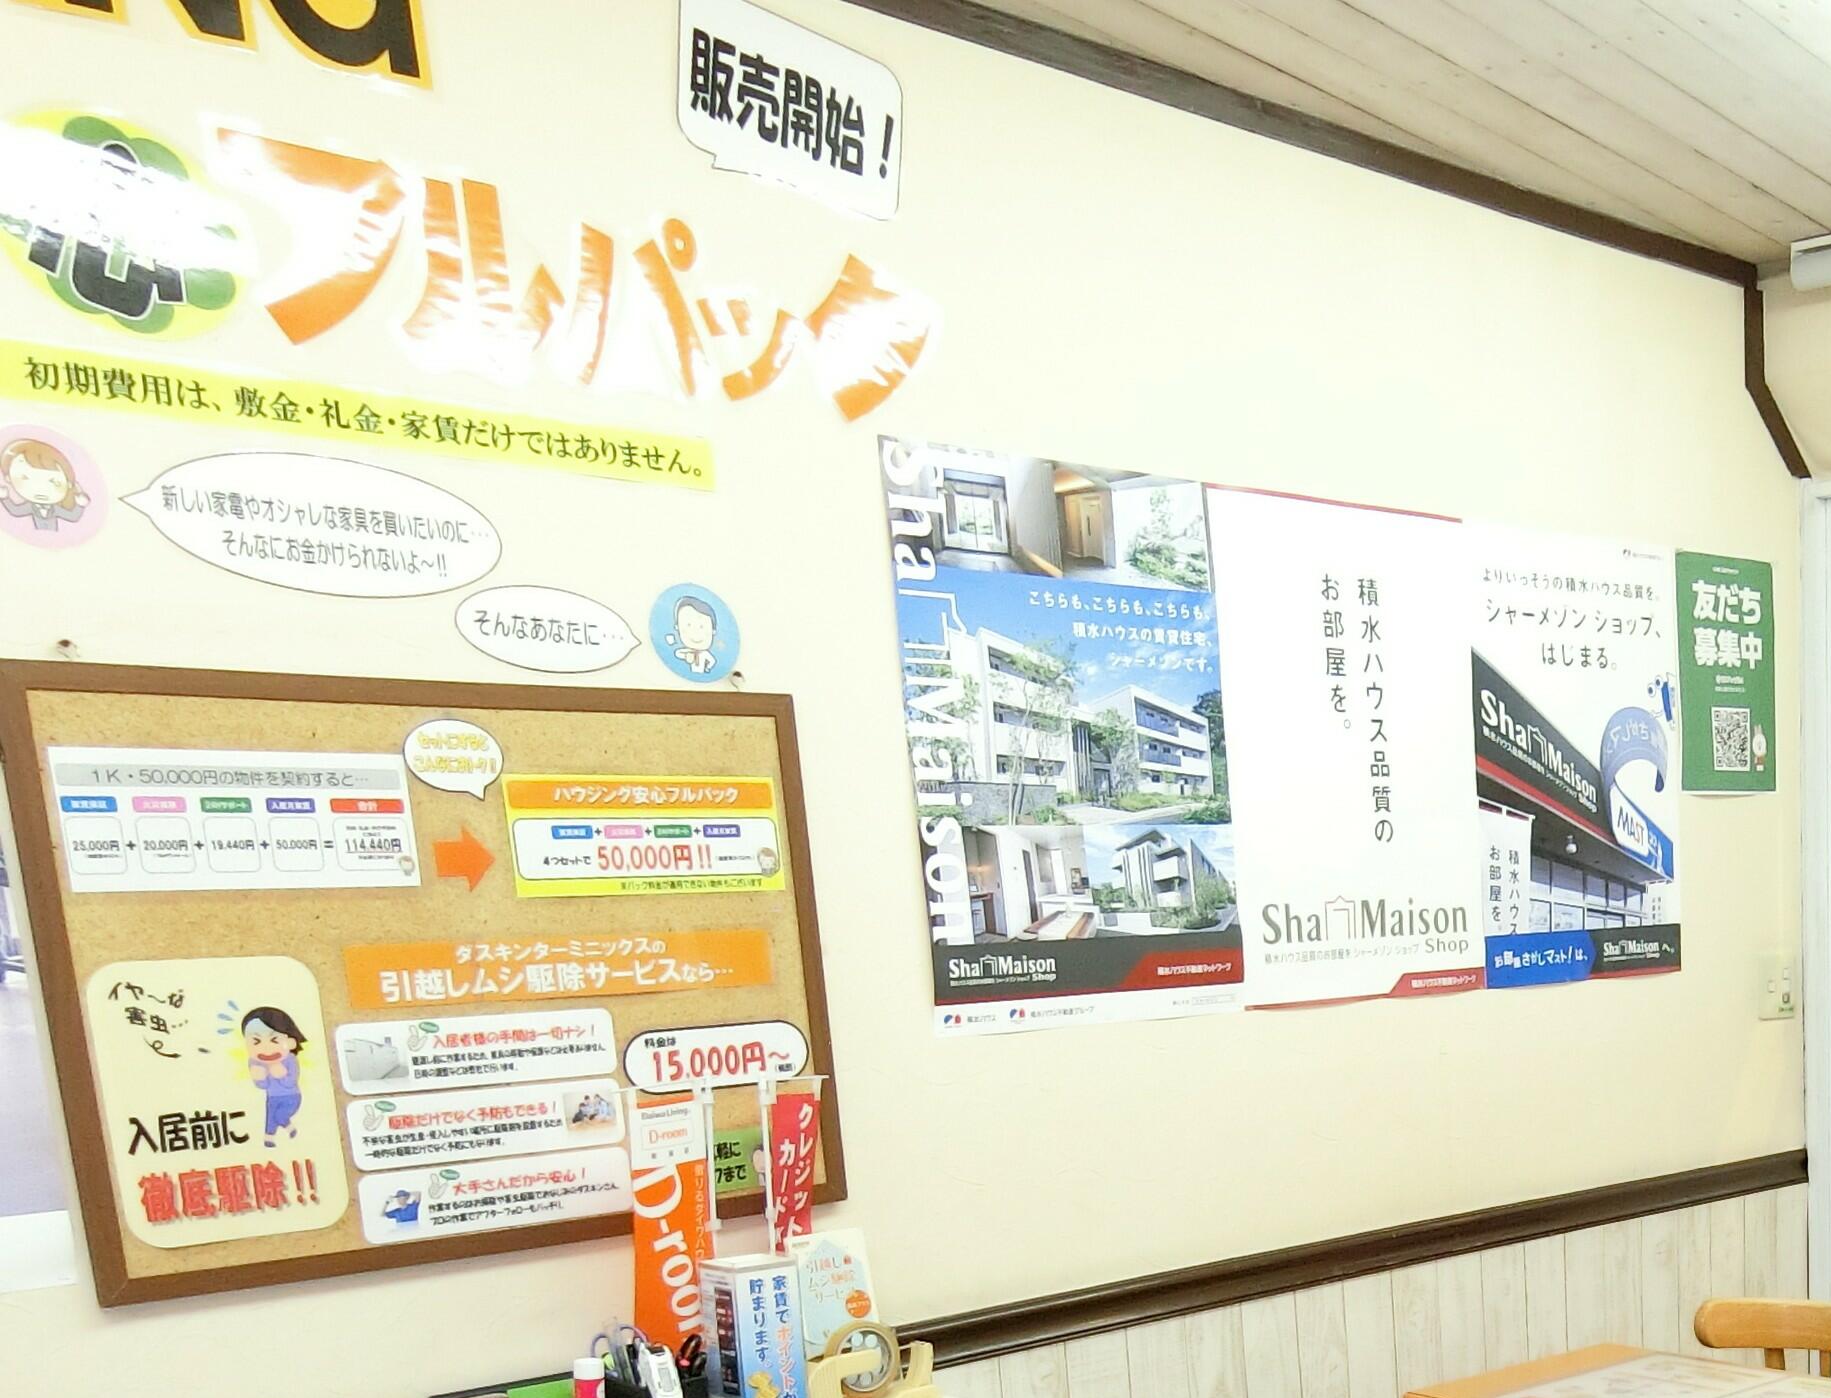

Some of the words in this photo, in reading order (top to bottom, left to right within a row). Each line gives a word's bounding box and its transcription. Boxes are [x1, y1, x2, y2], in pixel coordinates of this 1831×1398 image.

[688, 27, 897, 182] 販売開始！
[216, 127, 934, 424] フルパック
[1691, 579, 1761, 625] 友だち
[1320, 573, 1353, 732] お部屋を。
[1541, 643, 1617, 670] はじまる。
[1693, 626, 1763, 670] 募集中
[1358, 577, 1395, 845] 積水ハウス品質の
[554, 786, 739, 805] ハウジング安心フルパック
[1617, 806, 1645, 844] MAST
[455, 938, 666, 963] ダスキンターミニックスの
[1424, 938, 1470, 955] Shop
[1032, 973, 1057, 983] Shop
[644, 1037, 676, 1048] 料金は
[127, 1110, 249, 1155] 入居前に
